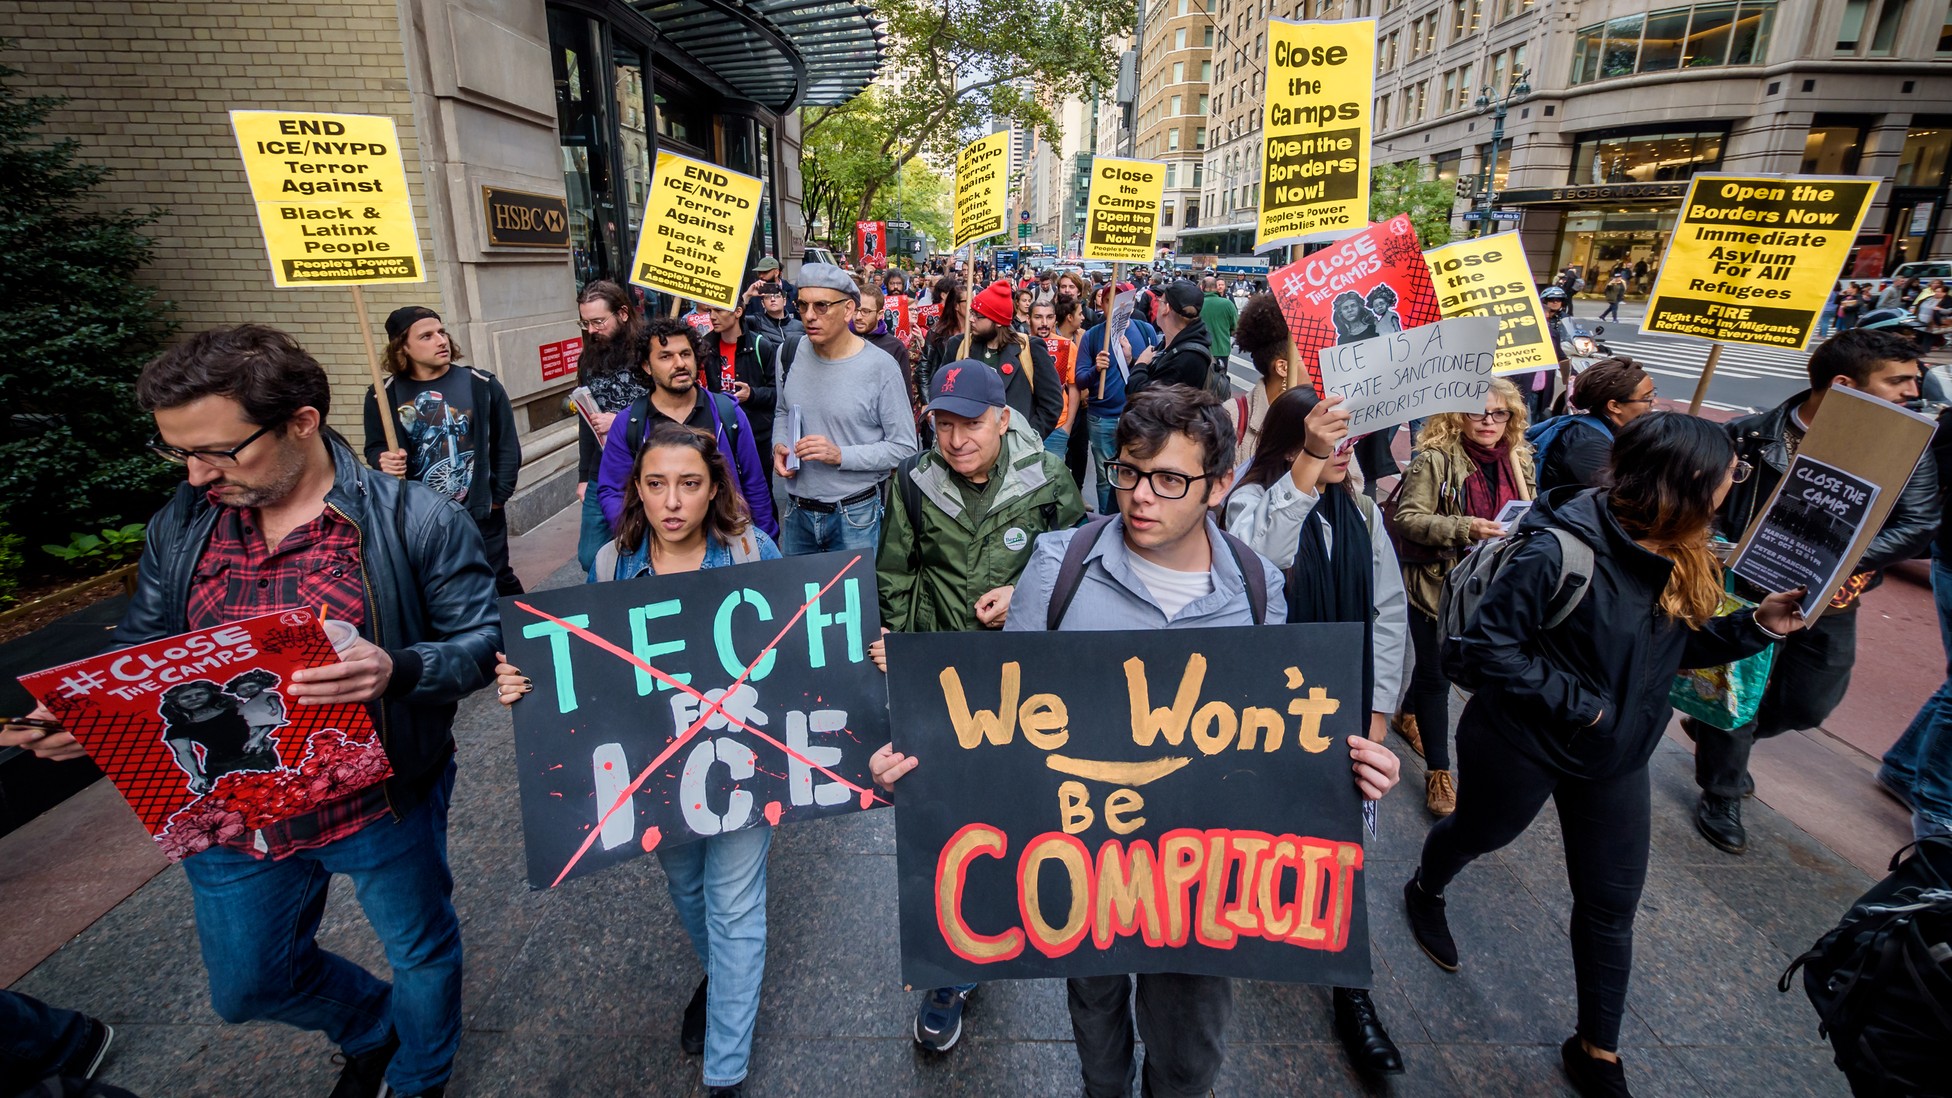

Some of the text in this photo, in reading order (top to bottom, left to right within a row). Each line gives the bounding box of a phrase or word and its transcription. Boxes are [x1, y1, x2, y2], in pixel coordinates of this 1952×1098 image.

[1275, 40, 1348, 67] Close
[1289, 78, 1321, 96] the
[1271, 101, 1360, 127] Camps
[278, 120, 345, 136] END
[257, 140, 388, 156] ICE/NYPD
[964, 142, 986, 160] END
[1269, 136, 1352, 161] Open the
[285, 161, 369, 174] Terror
[684, 165, 728, 187] END
[962, 163, 991, 181] Terror
[1101, 167, 1154, 183] Close
[1269, 157, 1357, 183] Borders
[281, 178, 383, 195] Against
[663, 176, 750, 210] ICE/NYPD
[960, 171, 996, 195] Against
[1119, 184, 1138, 195] the
[1275, 181, 1325, 204] Now!
[1720, 183, 1834, 202] Open the
[675, 195, 731, 219] Terror
[957, 187, 992, 209] Black &
[961, 199, 988, 216] Latinx
[1098, 195, 1156, 210] Camps
[280, 206, 381, 220] Black &
[493, 203, 543, 231] HSBC
[665, 208, 735, 236] Against
[961, 208, 992, 226] People
[1096, 211, 1151, 224] Open the
[1265, 205, 1347, 225] People's Power
[1689, 205, 1839, 225] Borders Now
[301, 223, 377, 237] Latinx
[1097, 222, 1152, 235] Borders
[1263, 215, 1350, 237] Assemblies NYC
[304, 240, 390, 255] People
[657, 225, 726, 252] Black &
[1105, 234, 1136, 245] Now!
[1695, 227, 1827, 248] Immediate
[666, 241, 718, 264] Latinx
[1091, 251, 1129, 259] Assemblies
[1122, 246, 1146, 254] Power
[1708, 246, 1796, 266] Asylum
[292, 266, 409, 279] Assemblies NYC
[293, 258, 404, 271] People's Power
[662, 254, 722, 279] People
[1713, 262, 1791, 281] For All
[644, 273, 727, 300] Assemblies NYC
[649, 265, 726, 292] People's Power
[1305, 254, 1382, 306] THE CAMPS
[1447, 273, 1485, 288] the
[1441, 281, 1526, 309] amps
[1689, 279, 1792, 300] Refugees
[1493, 302, 1527, 315] the
[1707, 304, 1753, 320] FIRE
[1655, 320, 1797, 345] Refugees Everywhere
[1658, 311, 1800, 335] Fight For Im/Migrants
[1330, 324, 1443, 373] ICE IS A
[1495, 347, 1537, 359] Power
[1516, 354, 1542, 364] NYC
[1329, 351, 1495, 400] STATE SANCTIONED
[1346, 385, 1433, 428] TERRORIST
[1796, 467, 1868, 506] CLOSE THE
[1802, 488, 1851, 516] CAMPS
[1760, 533, 1777, 544] SAT.
[1763, 527, 1790, 542] MARCH
[1795, 541, 1817, 556] RALLY
[1753, 543, 1777, 558] PETER
[1776, 554, 1814, 577] FRANCISCO
[522, 577, 864, 714] TECH
[107, 643, 259, 702] THE CAMPS
[670, 683, 768, 737] FOR
[939, 652, 1341, 756] We Won't
[1058, 780, 1147, 835] Be
[935, 822, 1364, 964] COMPLICIT
